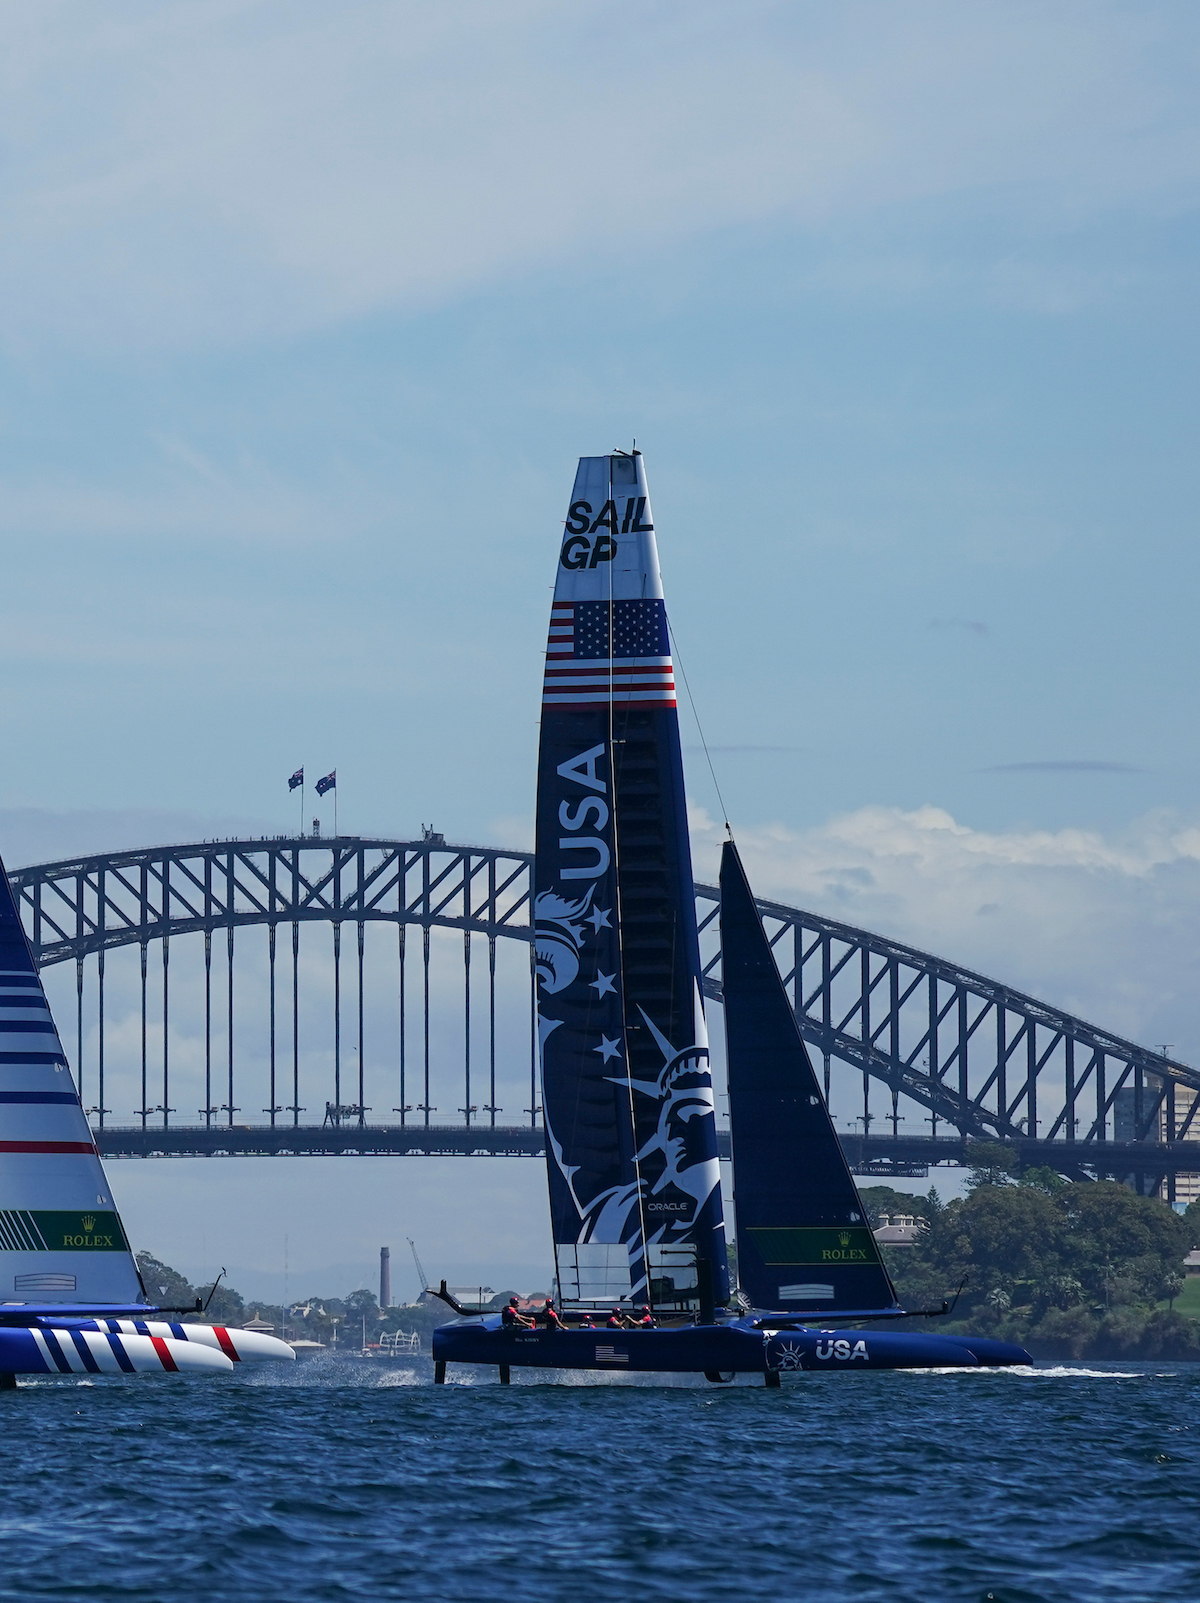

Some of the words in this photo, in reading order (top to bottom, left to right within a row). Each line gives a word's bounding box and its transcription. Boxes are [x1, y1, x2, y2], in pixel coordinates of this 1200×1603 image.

[565, 496, 654, 535] SAIL
[560, 535, 618, 570] GP
[556, 742, 611, 880] USA
[647, 1202, 688, 1212] ORACLE
[63, 1235, 113, 1246] ROLEX
[822, 1249, 867, 1260] ROLEX
[815, 1339, 870, 1361] USA
